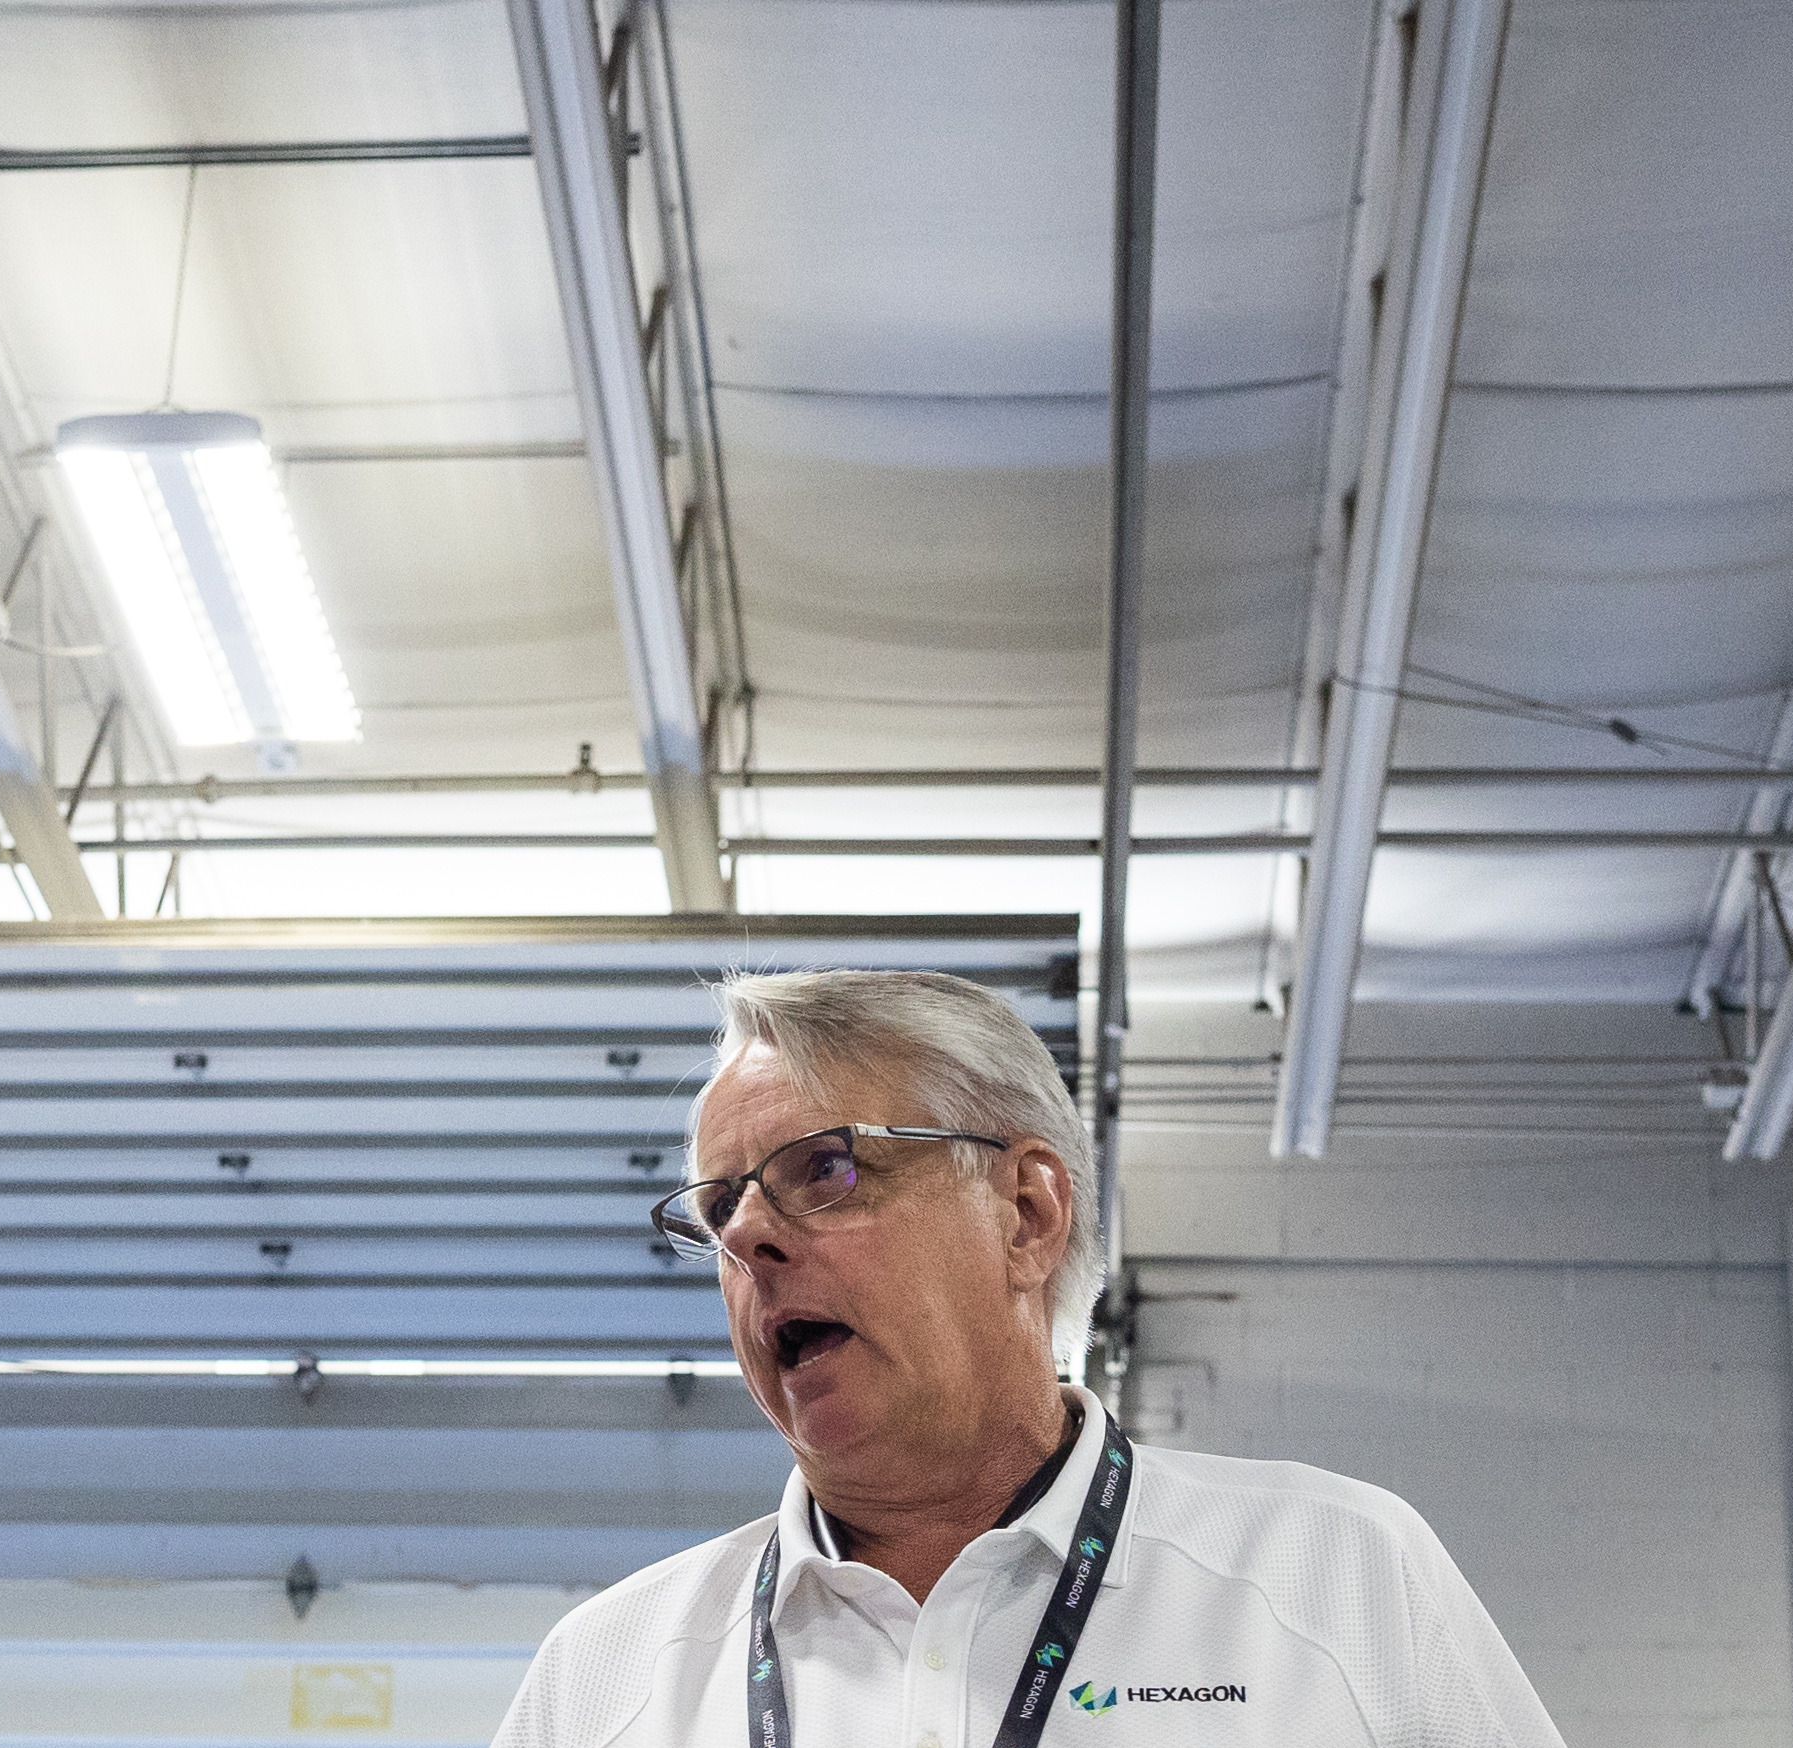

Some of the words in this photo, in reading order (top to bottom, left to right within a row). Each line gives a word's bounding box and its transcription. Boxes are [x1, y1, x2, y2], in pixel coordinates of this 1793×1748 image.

[1099, 1465, 1119, 1509] HEXAGON
[1066, 1558, 1093, 1609] HEXAGON
[1019, 1669, 1049, 1719] HEXAGON
[1127, 1685, 1246, 1703] HEXAGON
